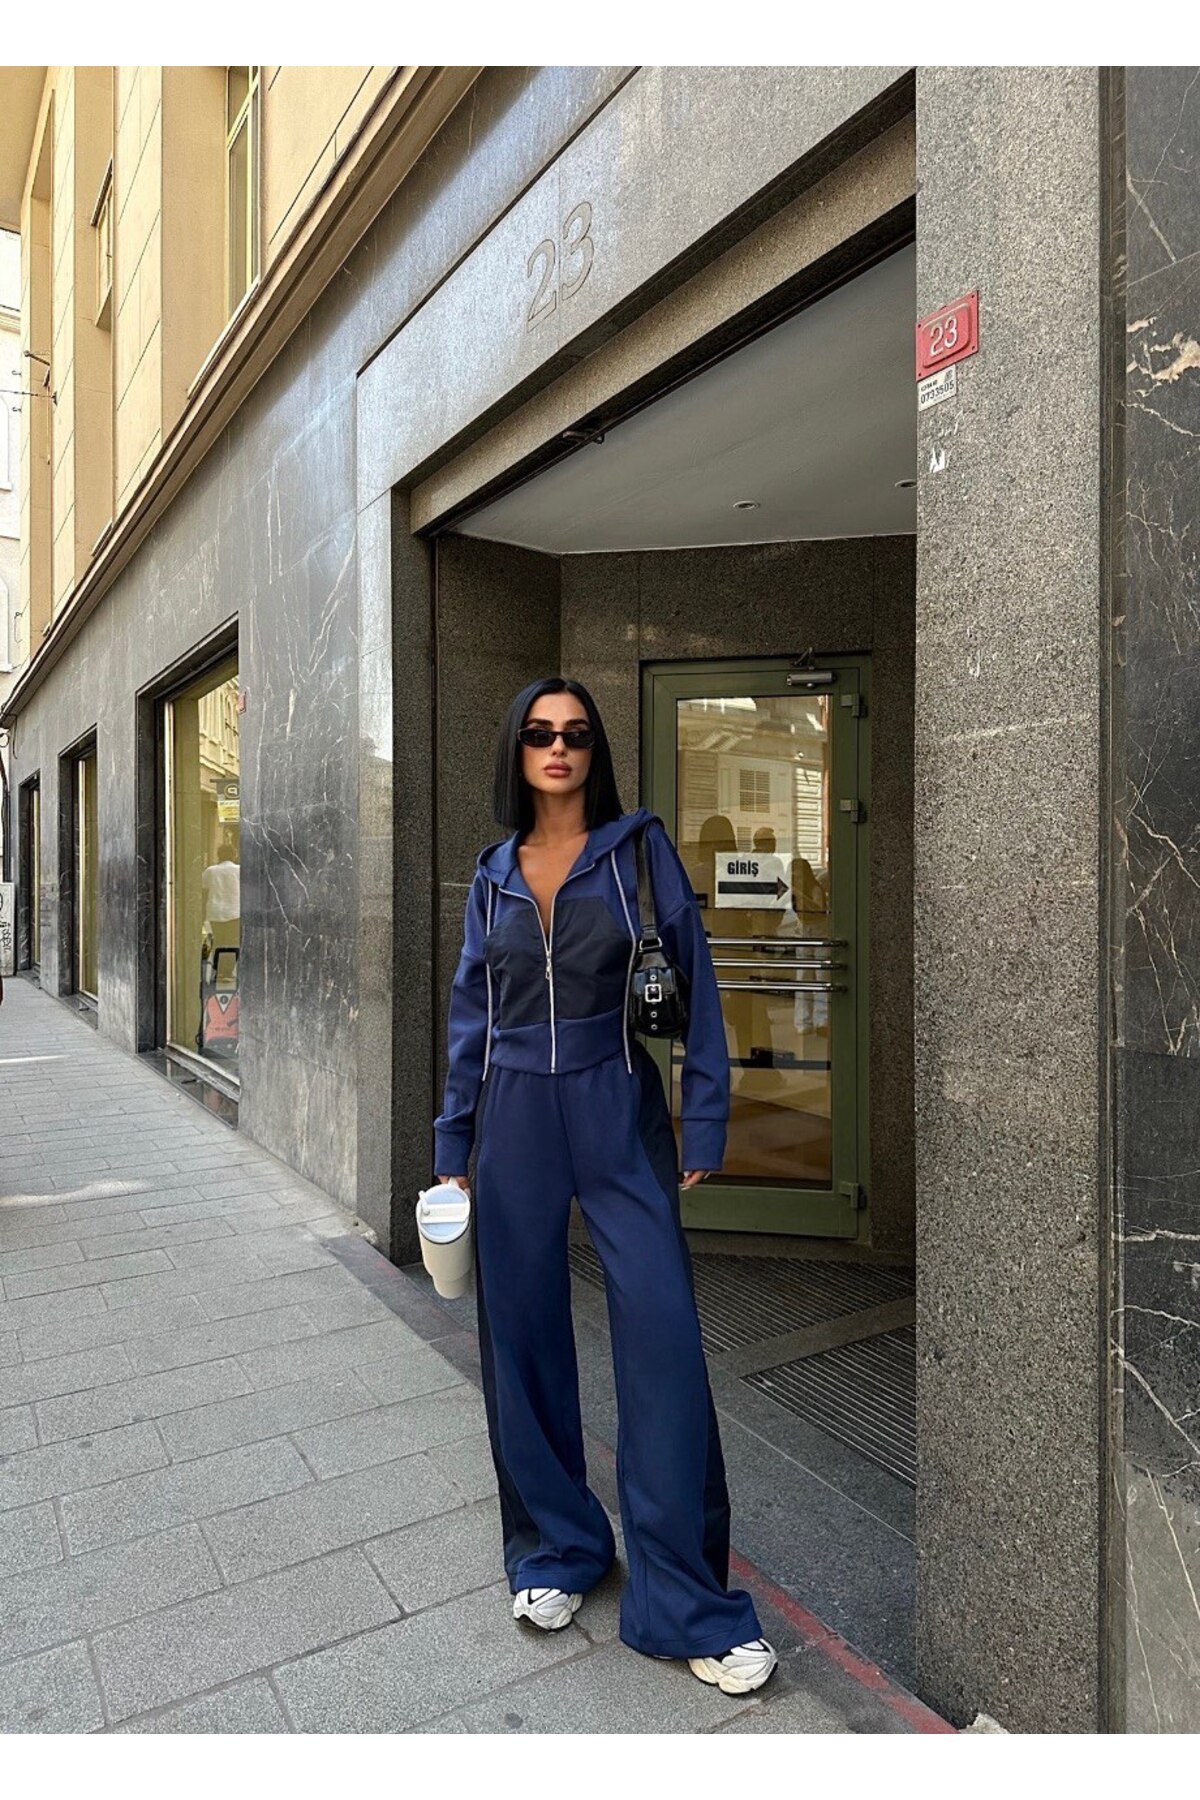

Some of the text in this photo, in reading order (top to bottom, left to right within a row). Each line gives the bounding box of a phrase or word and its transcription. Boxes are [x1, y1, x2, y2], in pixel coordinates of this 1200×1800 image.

[527, 201, 594, 334] 23
[930, 316, 957, 357] 23
[727, 860, 759, 877] GİRİŞ
